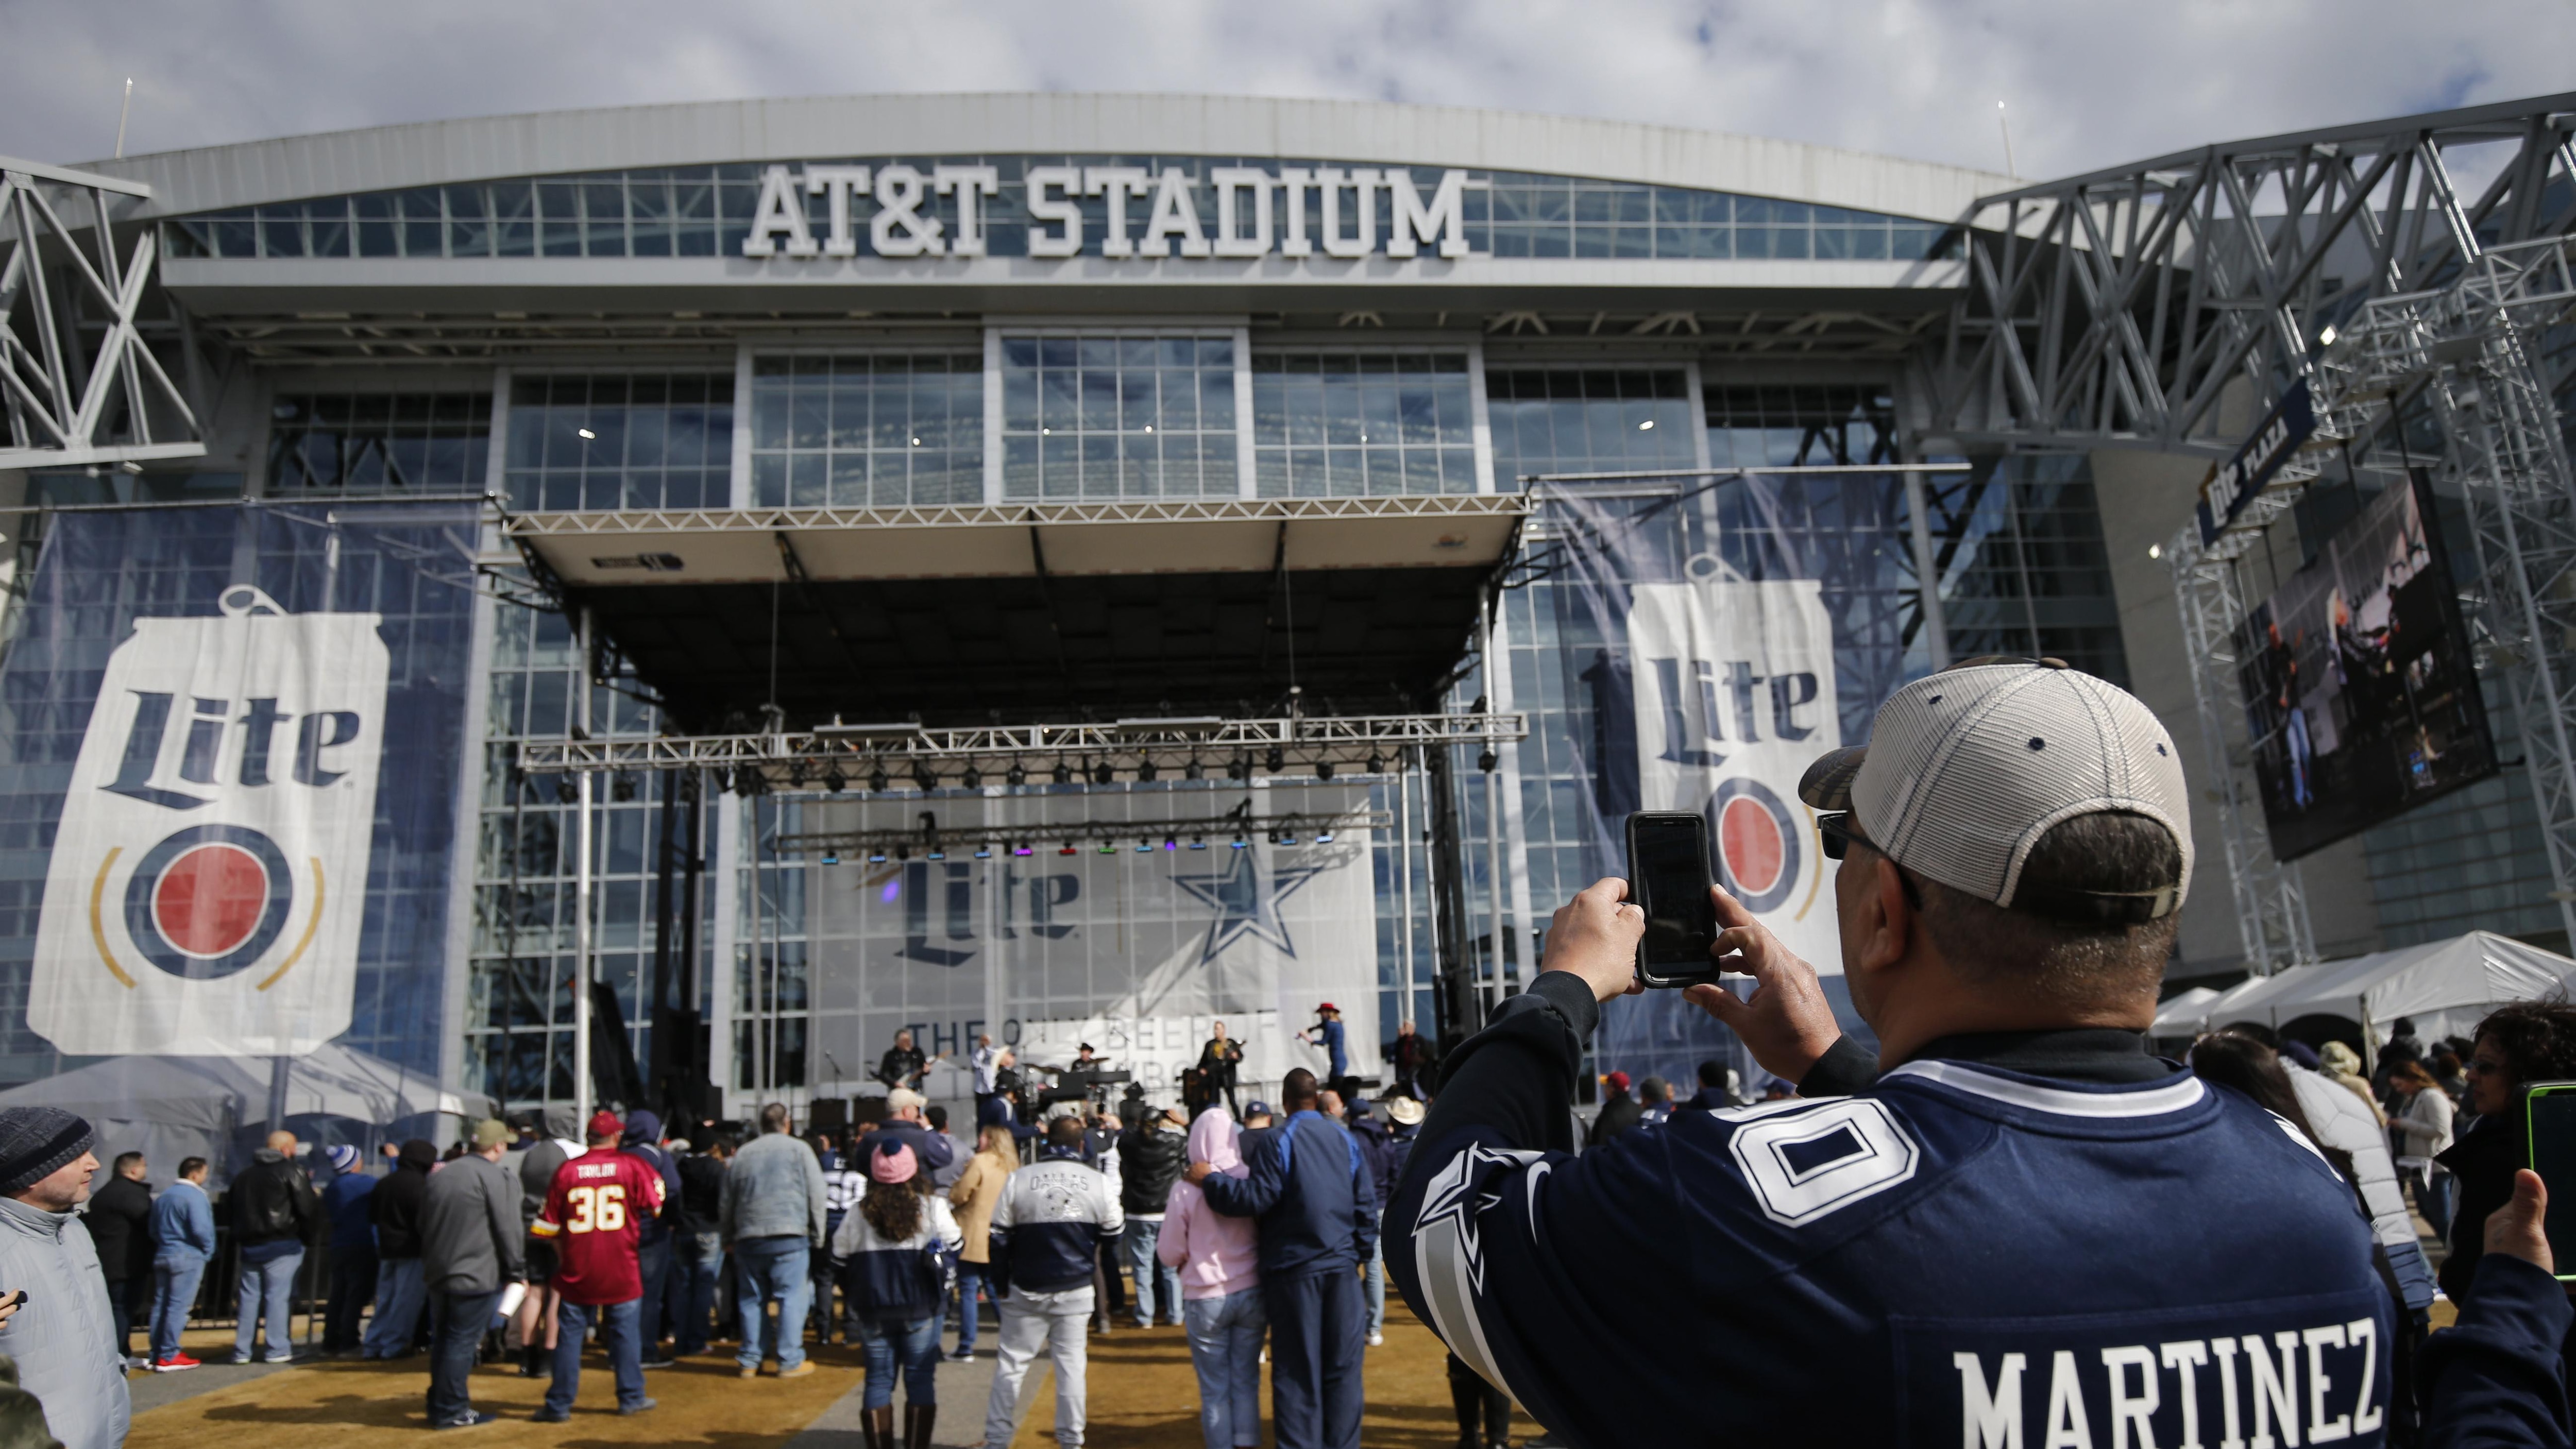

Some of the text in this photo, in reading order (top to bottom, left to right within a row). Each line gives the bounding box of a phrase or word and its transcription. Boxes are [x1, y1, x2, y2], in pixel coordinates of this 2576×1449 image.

[742, 164, 1469, 258] AT&T STADIUM
[2208, 417, 2289, 528] Lite PLAZA
[97, 689, 360, 810] Lite
[1647, 657, 1819, 766] Lite
[893, 861, 1080, 967] Lite
[567, 1184, 625, 1234] 36
[577, 1162, 617, 1179] TAYLOR
[1954, 1317, 2382, 1449] MARTINEZ
